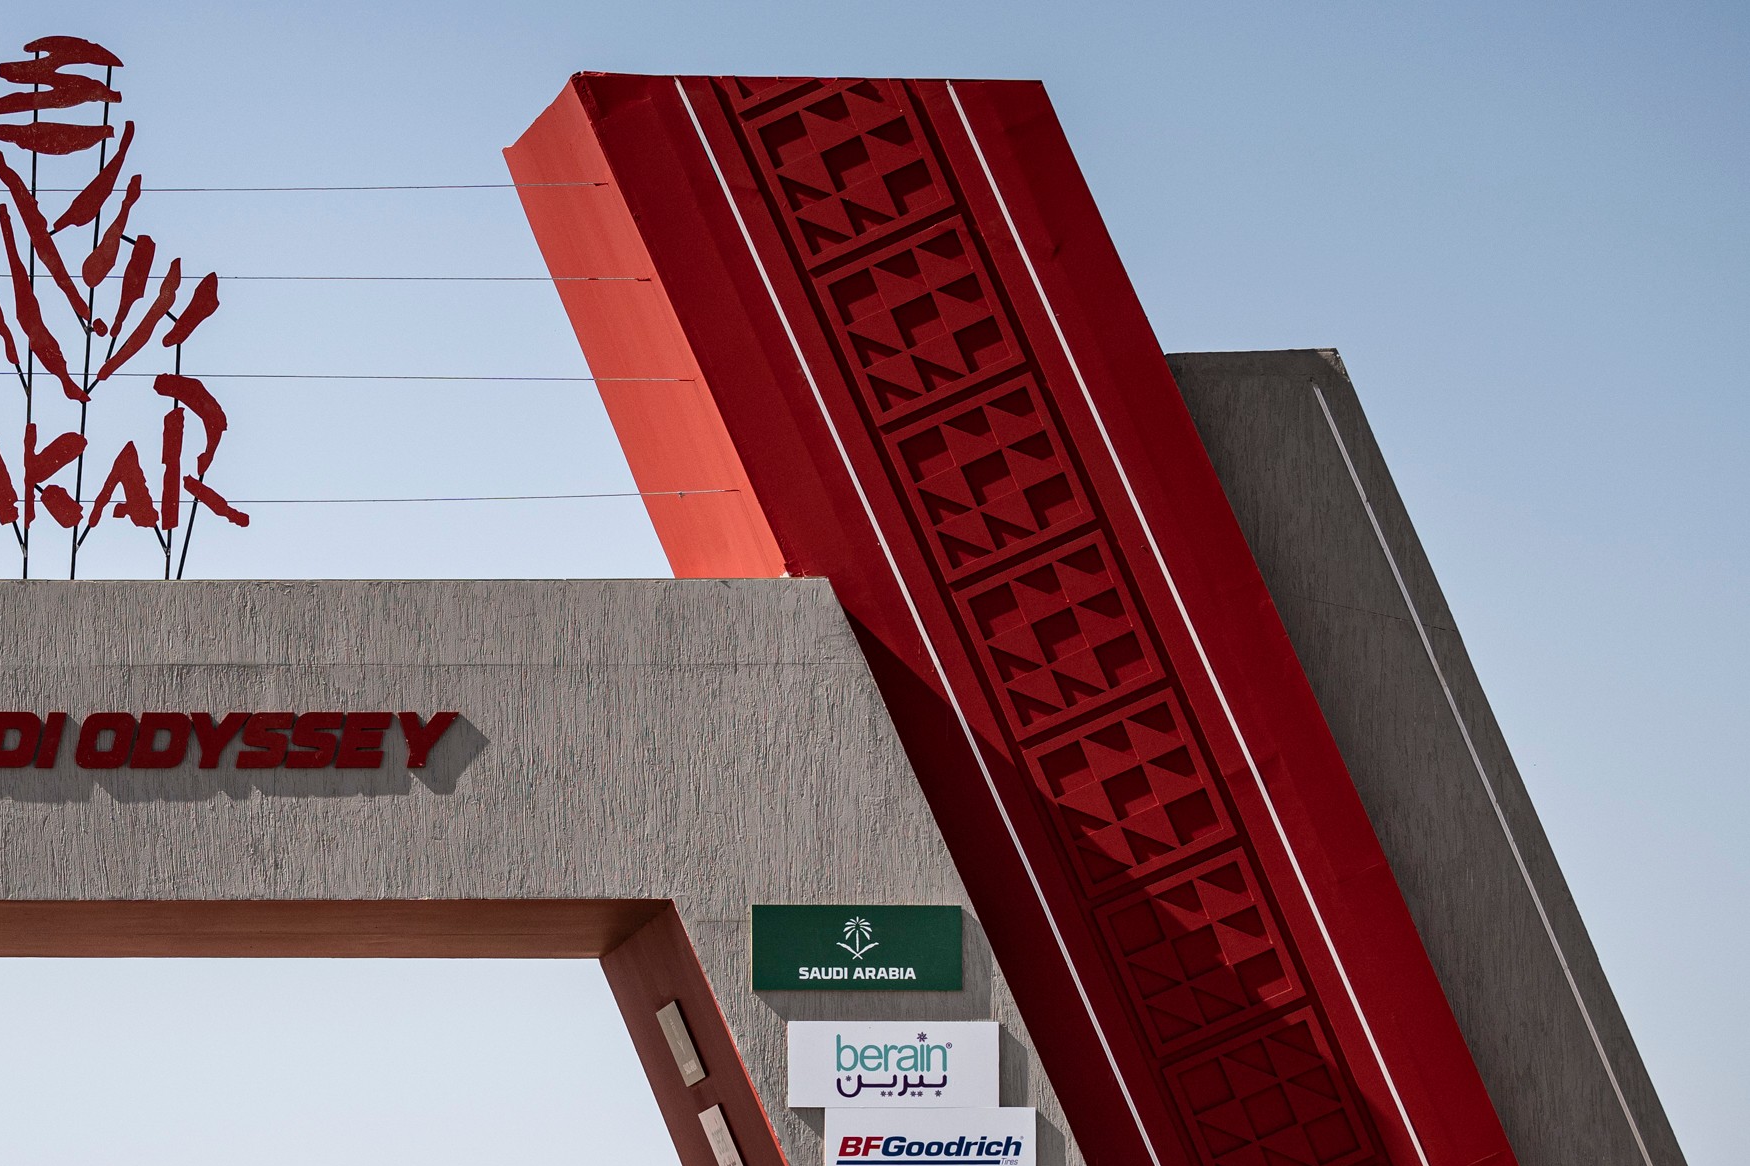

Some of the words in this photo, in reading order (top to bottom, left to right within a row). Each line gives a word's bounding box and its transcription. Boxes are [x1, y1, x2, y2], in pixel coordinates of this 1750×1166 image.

[74, 711, 460, 770] ODYSSEY
[798, 966, 848, 980] SAUDI
[852, 966, 917, 980] ARABIA
[836, 1031, 948, 1072] berain
[836, 1074, 948, 1098] بيرين
[838, 1135, 1022, 1157] BFGoodrich
[1000, 1157, 1019, 1166] Tires
